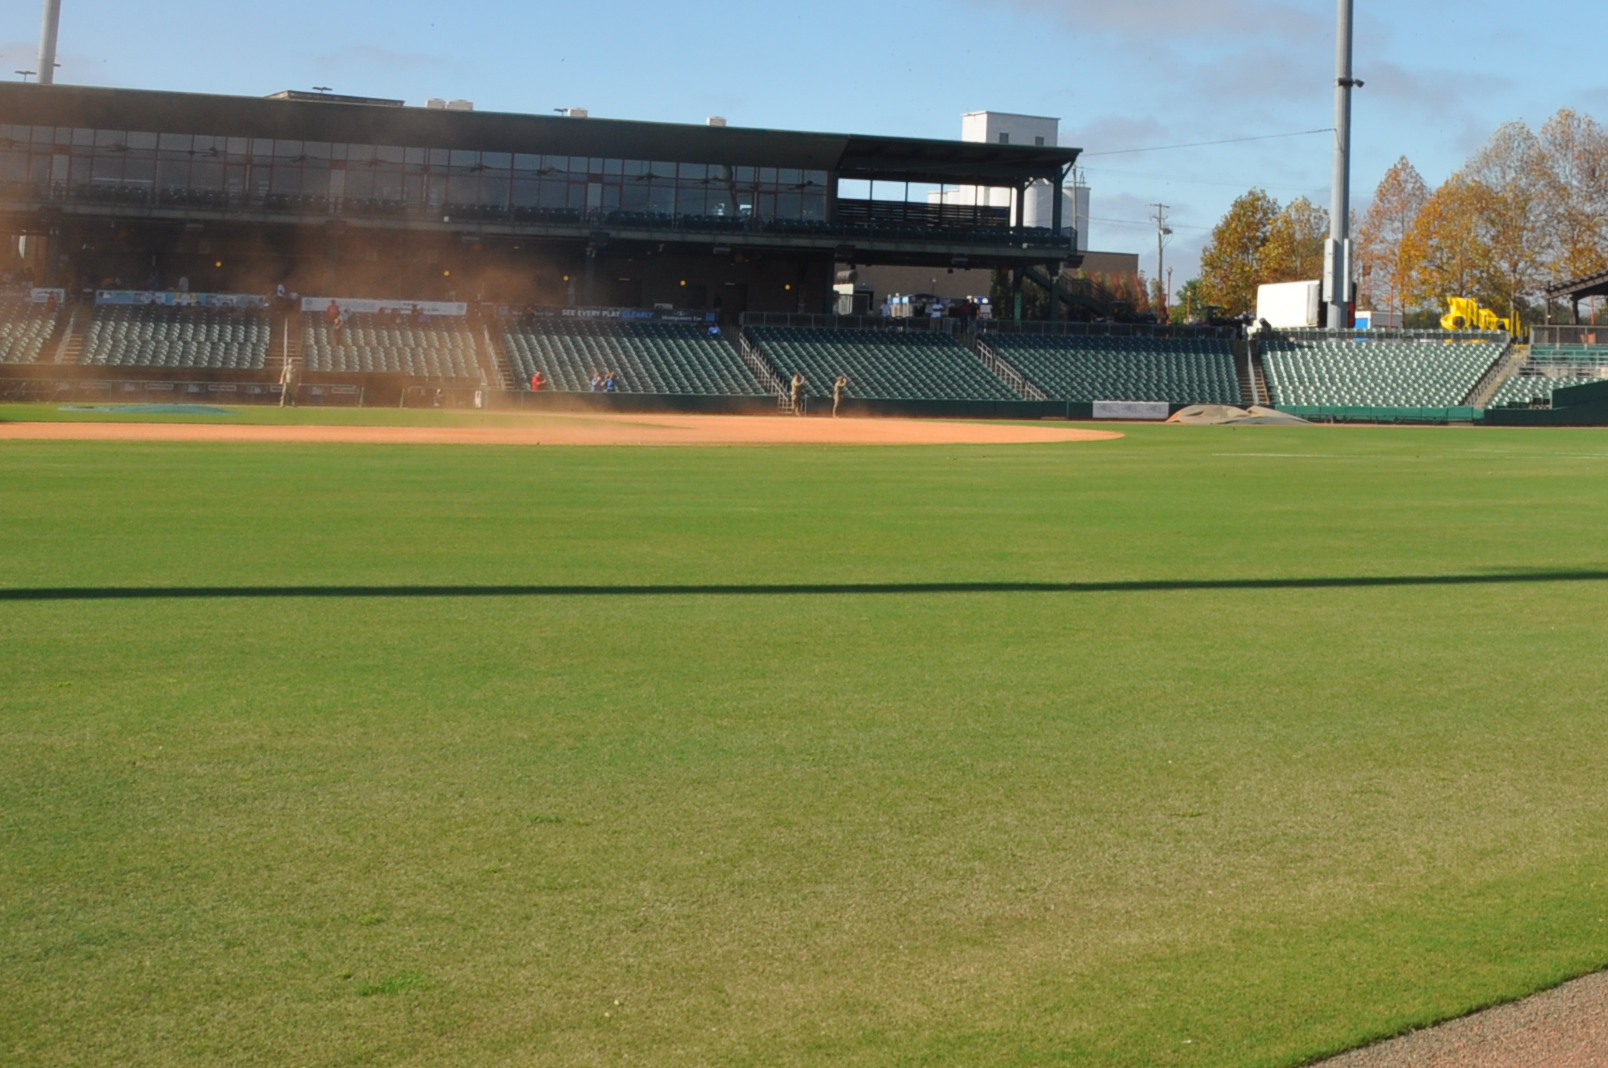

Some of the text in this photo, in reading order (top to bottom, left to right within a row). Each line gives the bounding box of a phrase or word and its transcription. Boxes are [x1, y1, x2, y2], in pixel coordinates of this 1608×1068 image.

[577, 309, 600, 318] EVERY
[602, 310, 621, 318] PLAY
[622, 311, 653, 319] CLEARLY
